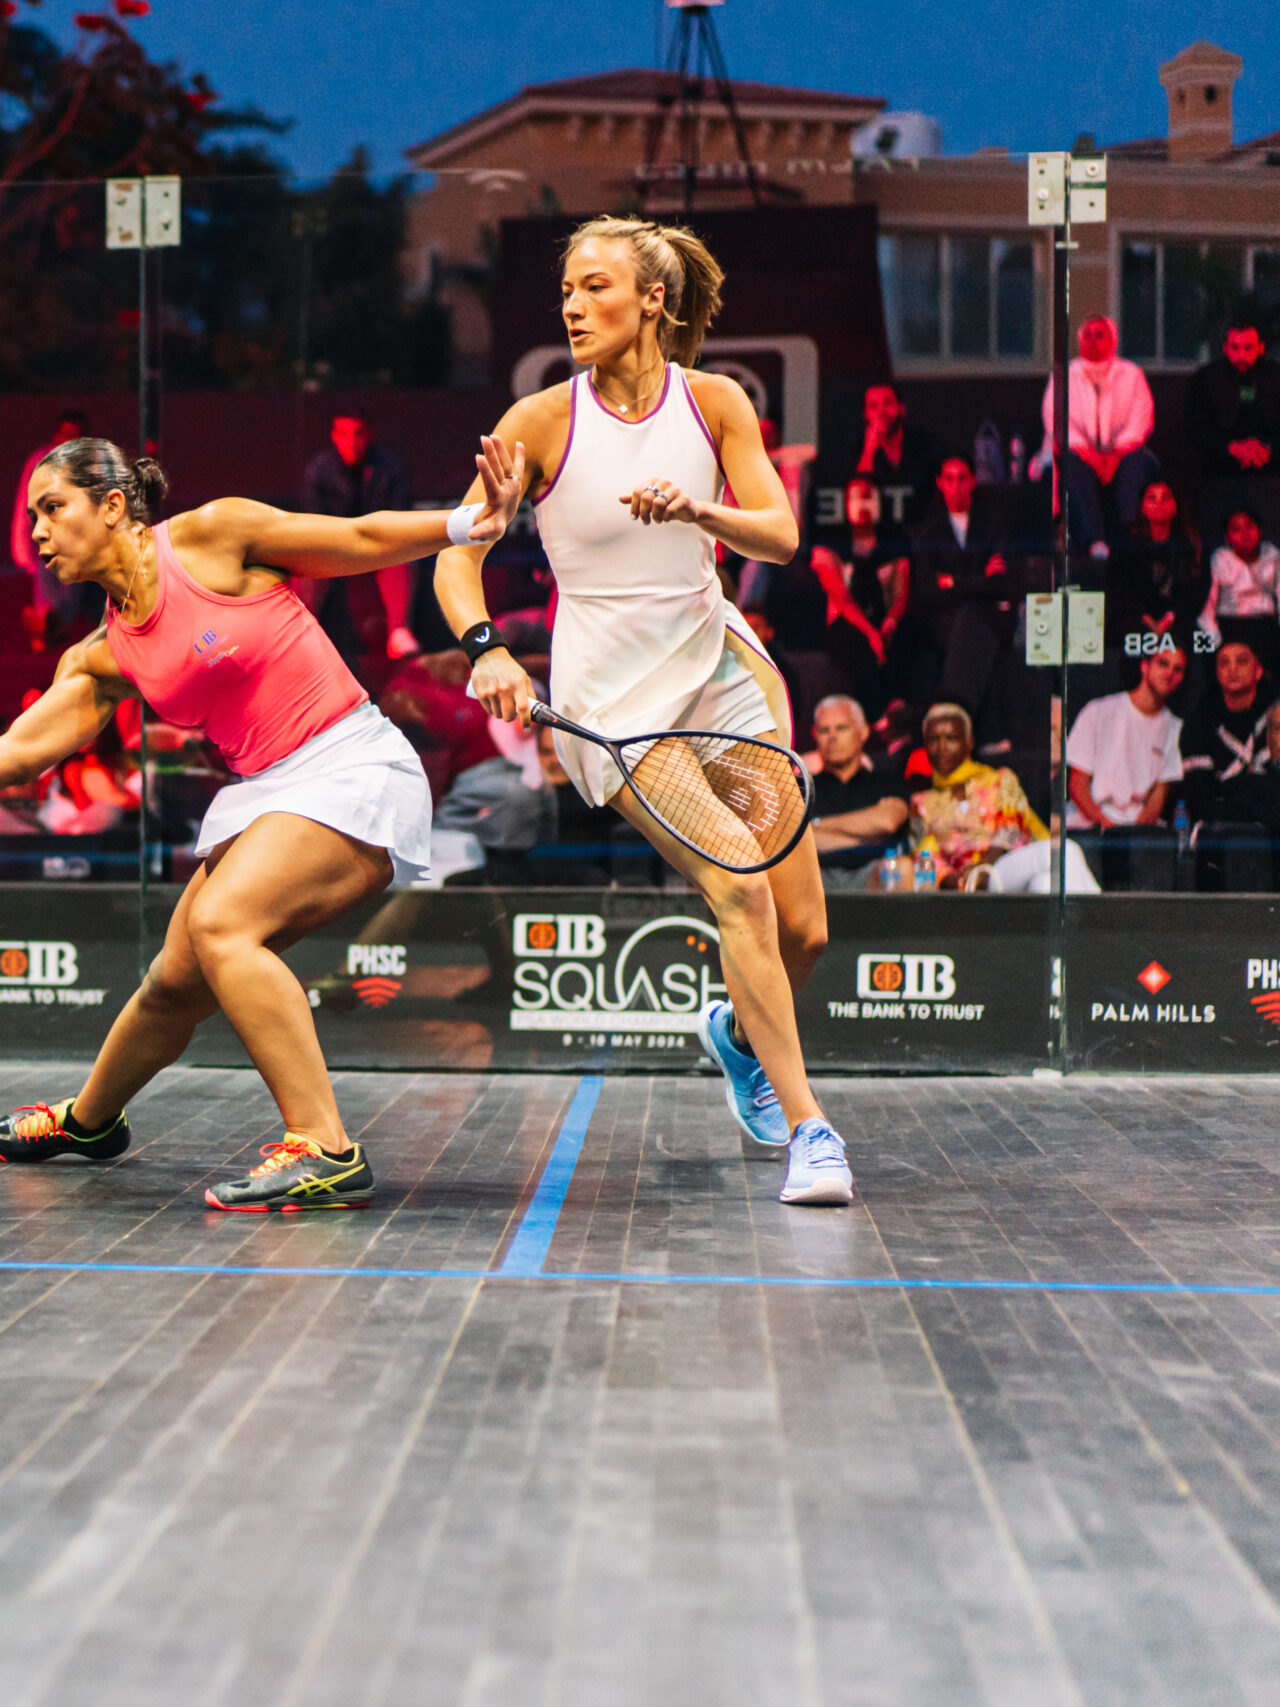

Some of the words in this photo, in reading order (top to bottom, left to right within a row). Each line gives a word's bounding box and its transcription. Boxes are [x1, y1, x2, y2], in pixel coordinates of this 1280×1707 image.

[512, 913, 608, 958] CIB
[348, 943, 407, 977] PHSC
[1246, 957, 1280, 991] PH
[856, 952, 957, 1000] CIB
[33, 988, 55, 1005] TO
[56, 989, 105, 1006] TRUST
[827, 1001, 859, 1018] THE
[861, 1002, 906, 1020] BANK
[908, 1003, 930, 1020] TO
[933, 1003, 985, 1021] TRUST
[1091, 1002, 1150, 1023] PALM
[1156, 1003, 1216, 1024] HILLS
[610, 1034, 643, 1047] MAY
